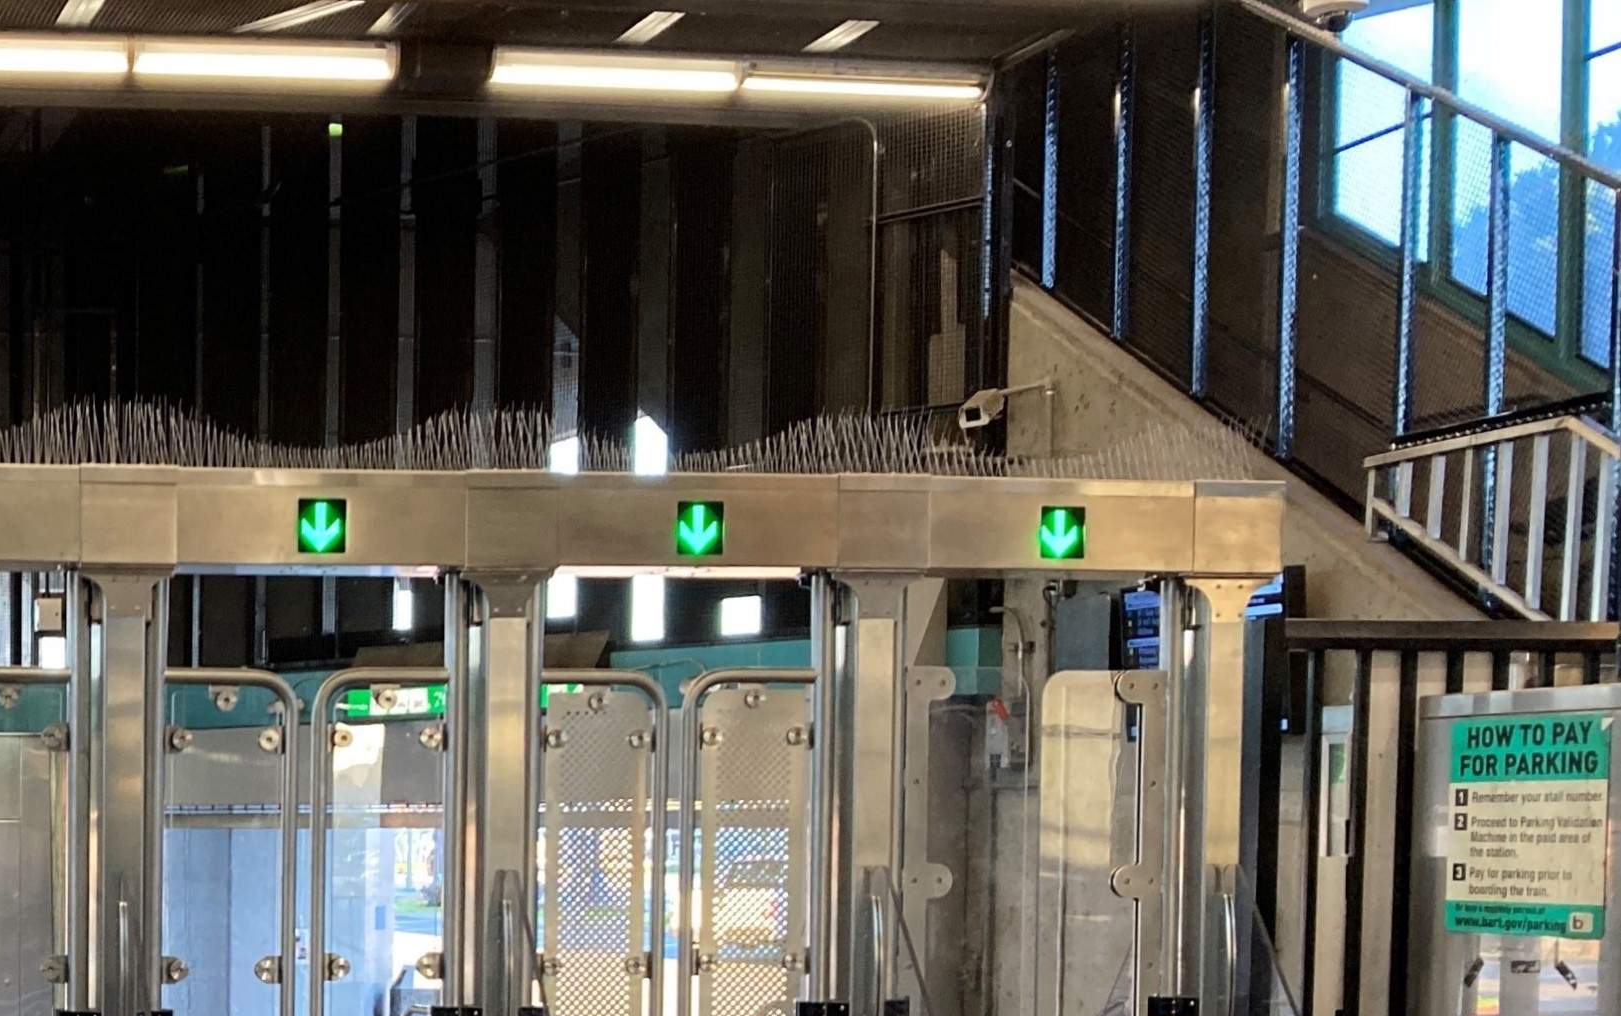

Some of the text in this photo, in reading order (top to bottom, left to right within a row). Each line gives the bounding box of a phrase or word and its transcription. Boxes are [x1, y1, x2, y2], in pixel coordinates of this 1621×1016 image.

[1467, 720, 1593, 749] HOW TO PAY
[1459, 750, 1598, 776] FOR PARKING
[1471, 791, 1519, 803] Remember
[1521, 792, 1541, 805] your
[1544, 791, 1564, 802] stall
[1471, 816, 1603, 830] Proceed to Parking Validation
[1470, 831, 1592, 845] Machine in the paid area of
[1470, 847, 1484, 857] the
[1469, 866, 1572, 882] Pay for parking prior to
[1469, 884, 1549, 898] boarding the train.
[1454, 916, 1567, 933] www.bart.gov/parking
